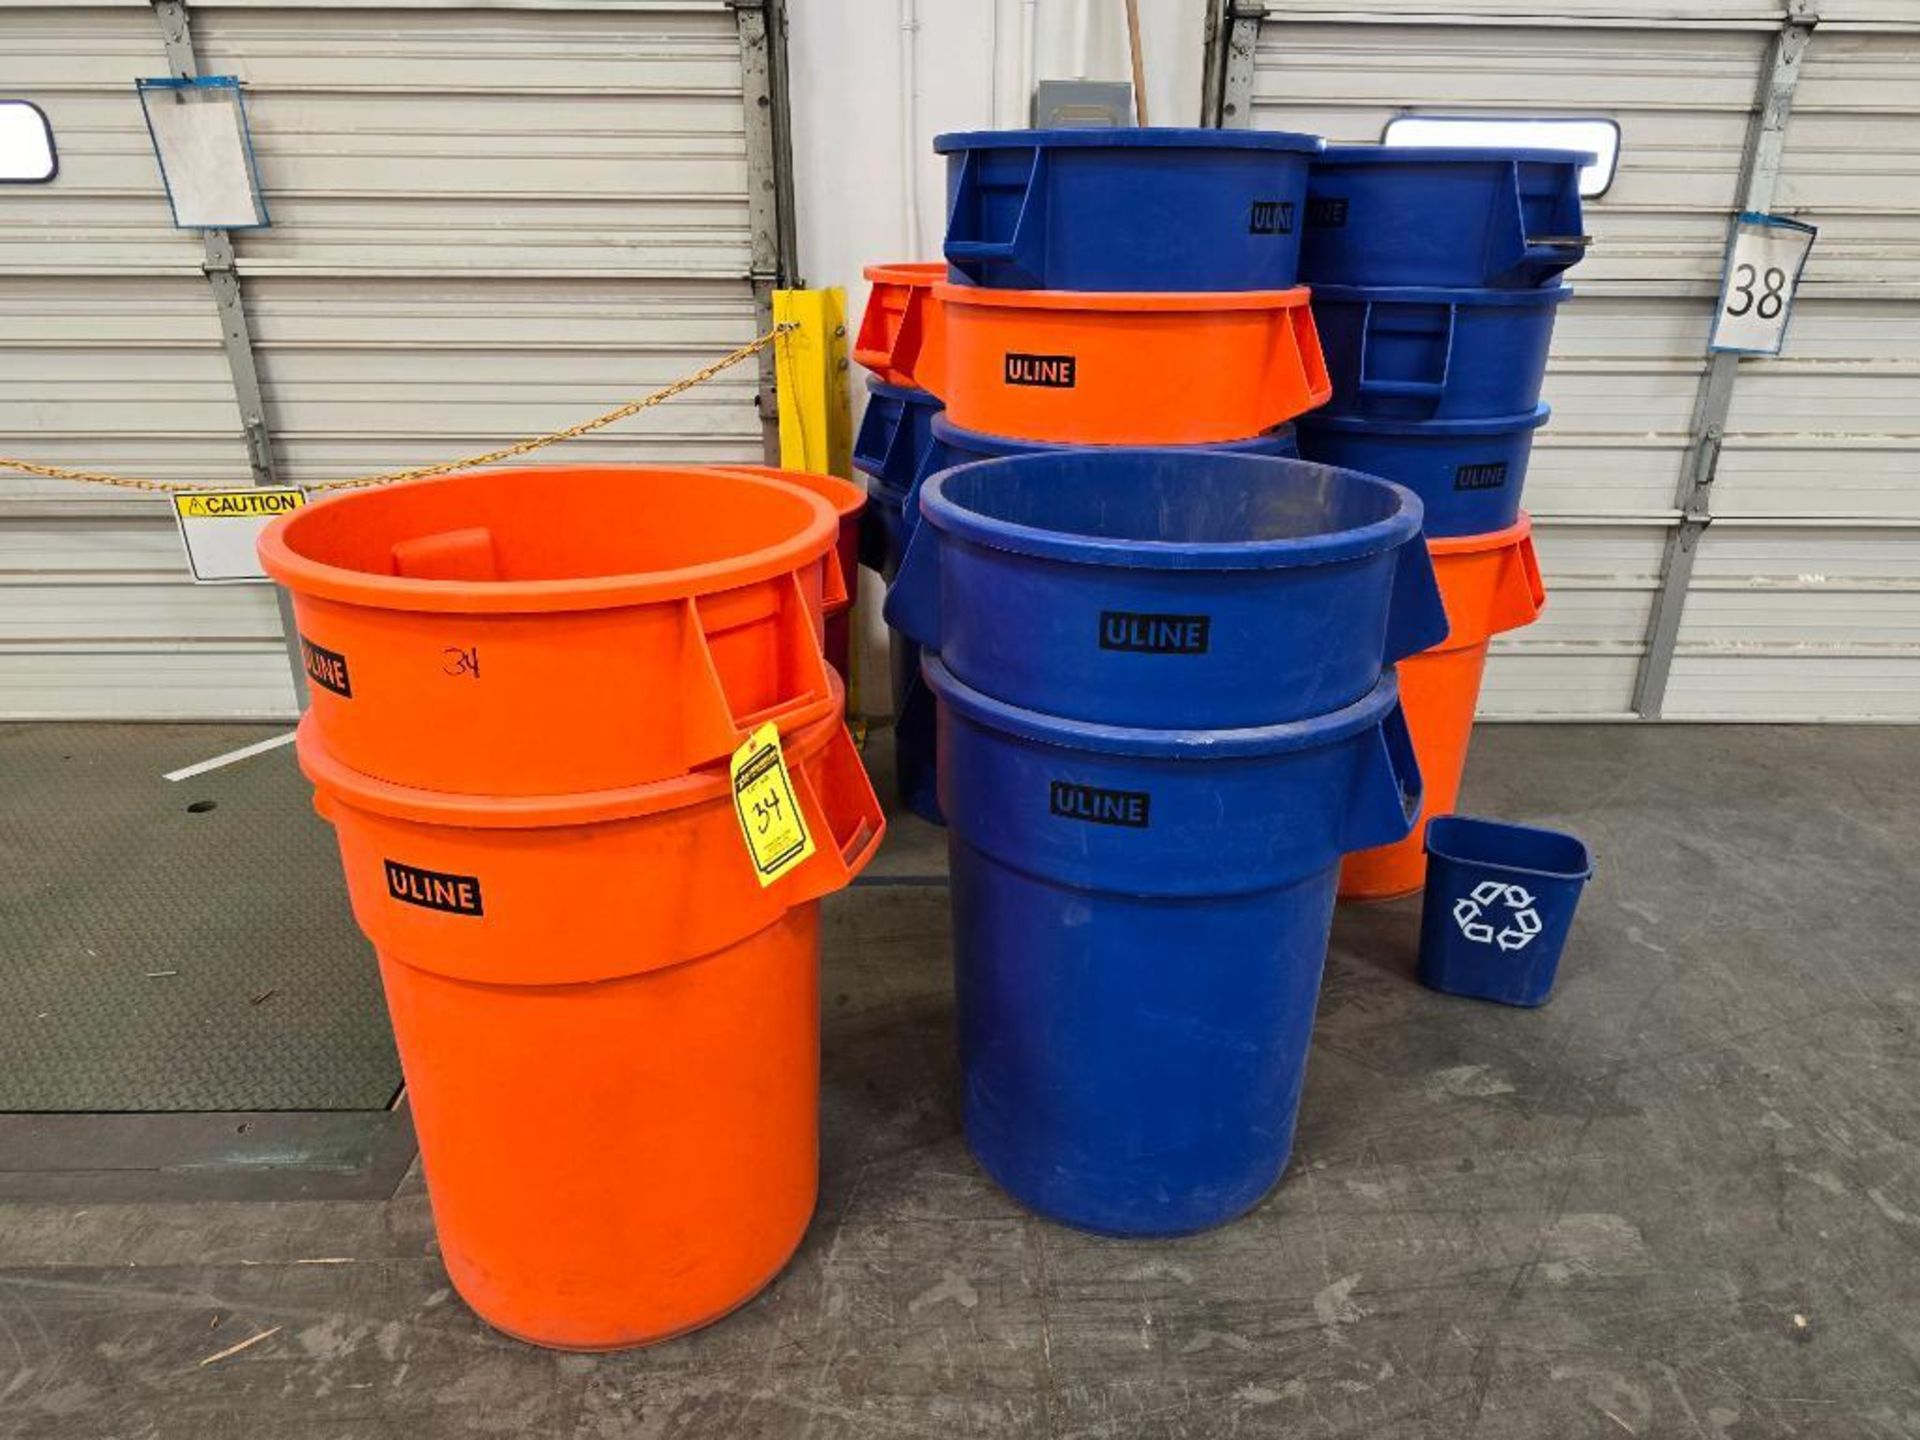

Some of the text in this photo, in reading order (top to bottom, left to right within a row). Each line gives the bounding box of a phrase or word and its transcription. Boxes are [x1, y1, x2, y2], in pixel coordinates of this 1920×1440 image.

[1726, 263, 1786, 319] 38
[1008, 358, 1071, 383] ULINE
[1459, 466, 1505, 487] ULINE
[205, 495, 296, 514] CAUTION
[1105, 617, 1202, 648] ULINE
[442, 647, 480, 679] 34
[751, 788, 783, 834] 34
[1056, 787, 1144, 822] ULINE
[390, 868, 475, 910] ULINE
